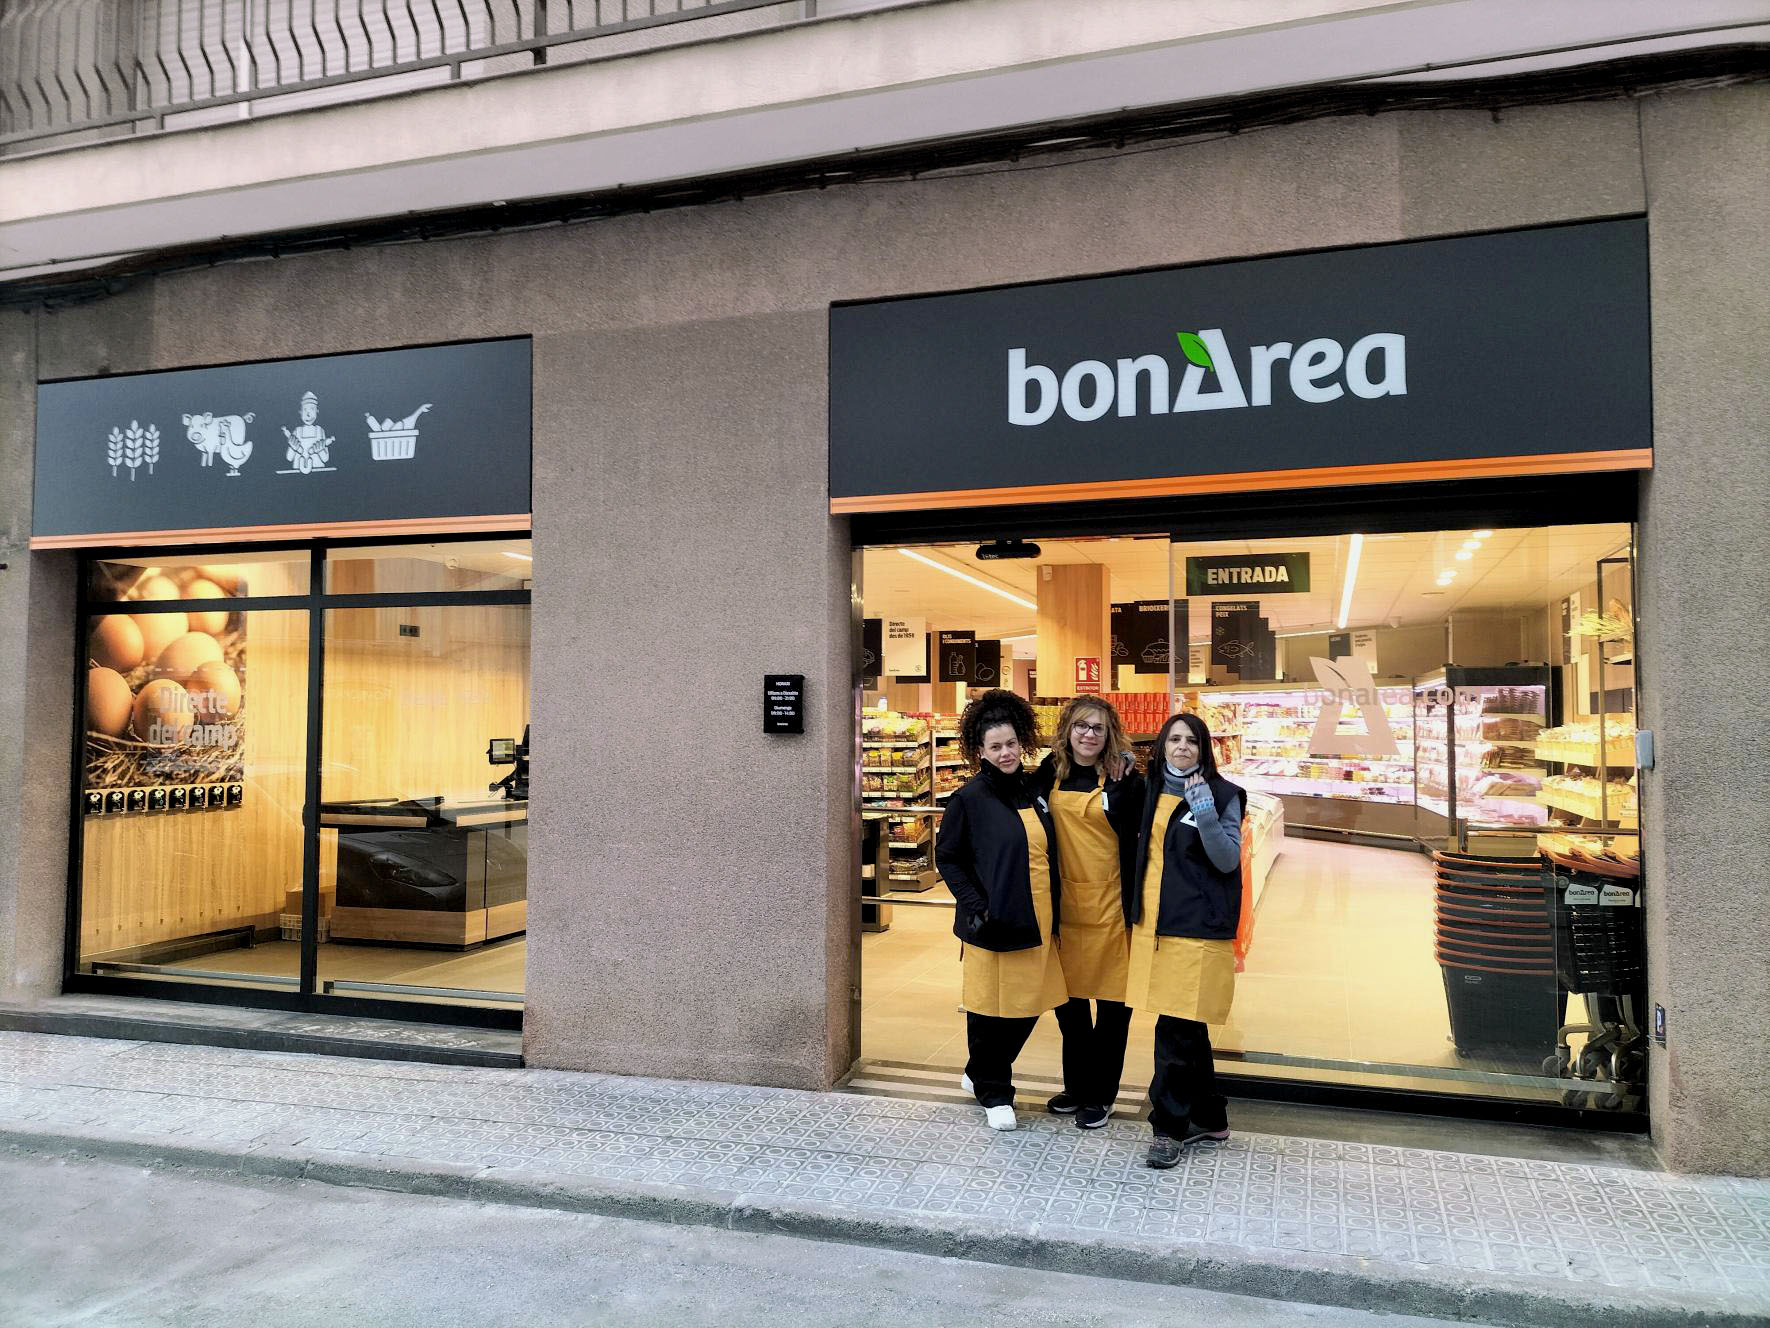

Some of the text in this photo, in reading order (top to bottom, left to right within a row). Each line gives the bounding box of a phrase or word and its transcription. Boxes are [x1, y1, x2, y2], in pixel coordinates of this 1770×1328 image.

[1207, 565, 1290, 585] ENTRADA
[160, 687, 229, 714] Directe
[148, 717, 238, 752] del camp
